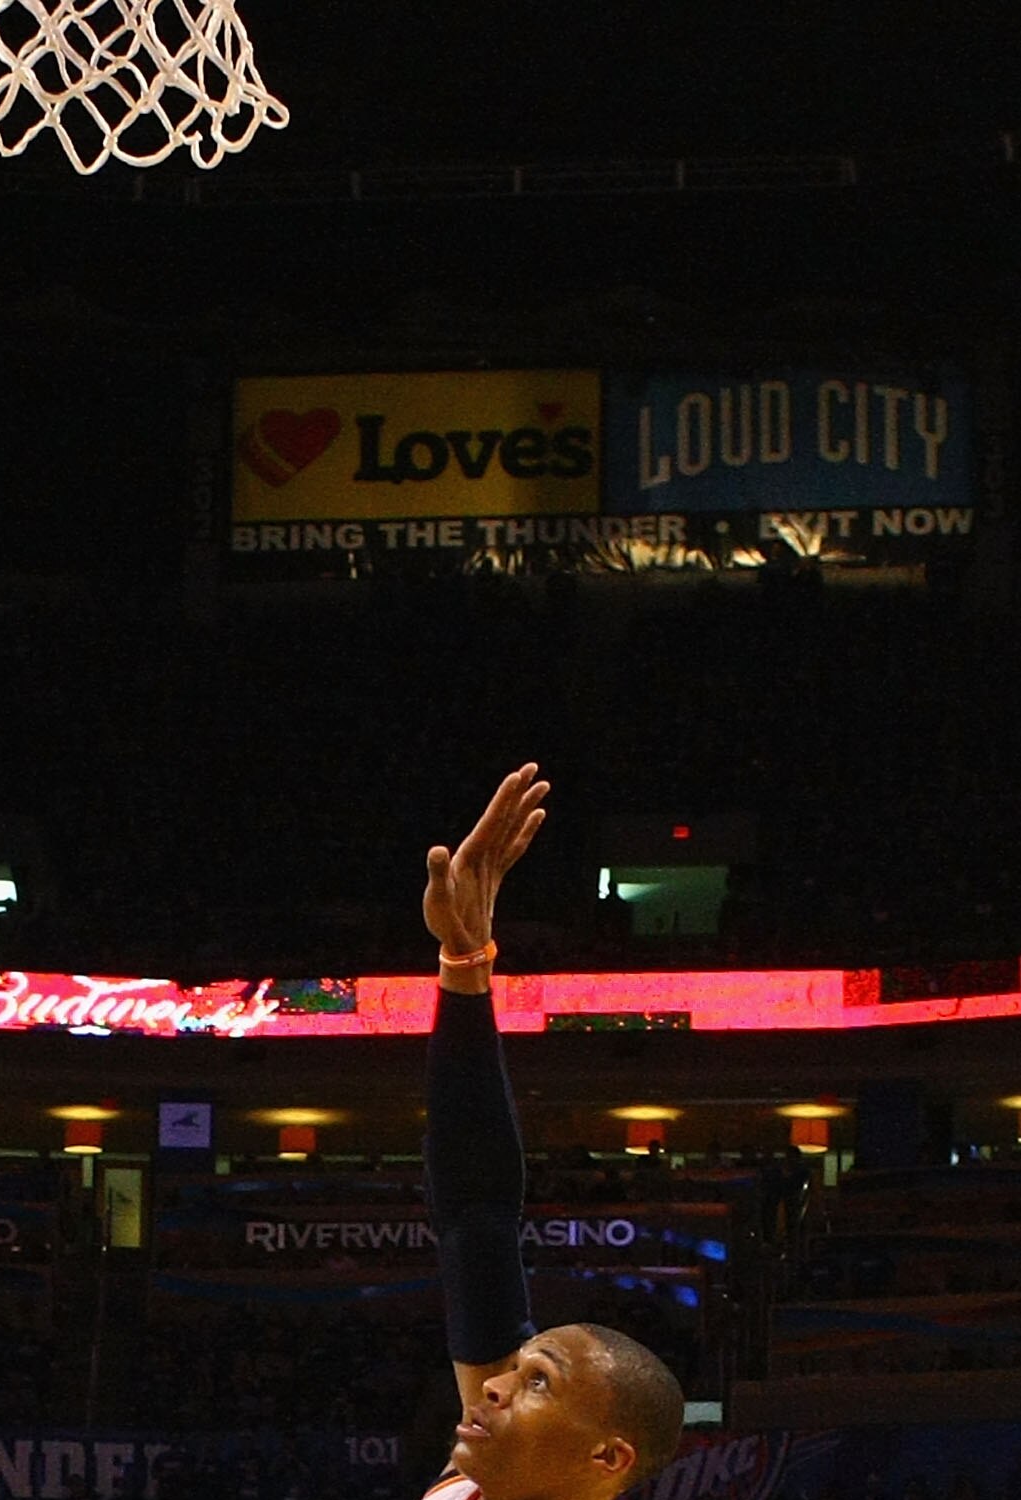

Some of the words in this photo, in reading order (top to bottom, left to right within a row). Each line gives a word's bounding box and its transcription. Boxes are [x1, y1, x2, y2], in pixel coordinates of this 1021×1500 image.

[638, 378, 794, 491] LOUD
[817, 377, 950, 481] CITY
[231, 522, 366, 552] BRING
[379, 520, 466, 550] THE
[477, 513, 689, 547] THUNDER
[870, 507, 974, 537] NOW
[245, 1220, 440, 1252] RIVERWIN
[519, 1218, 638, 1248] ASINO
[344, 1435, 401, 1467] 101
